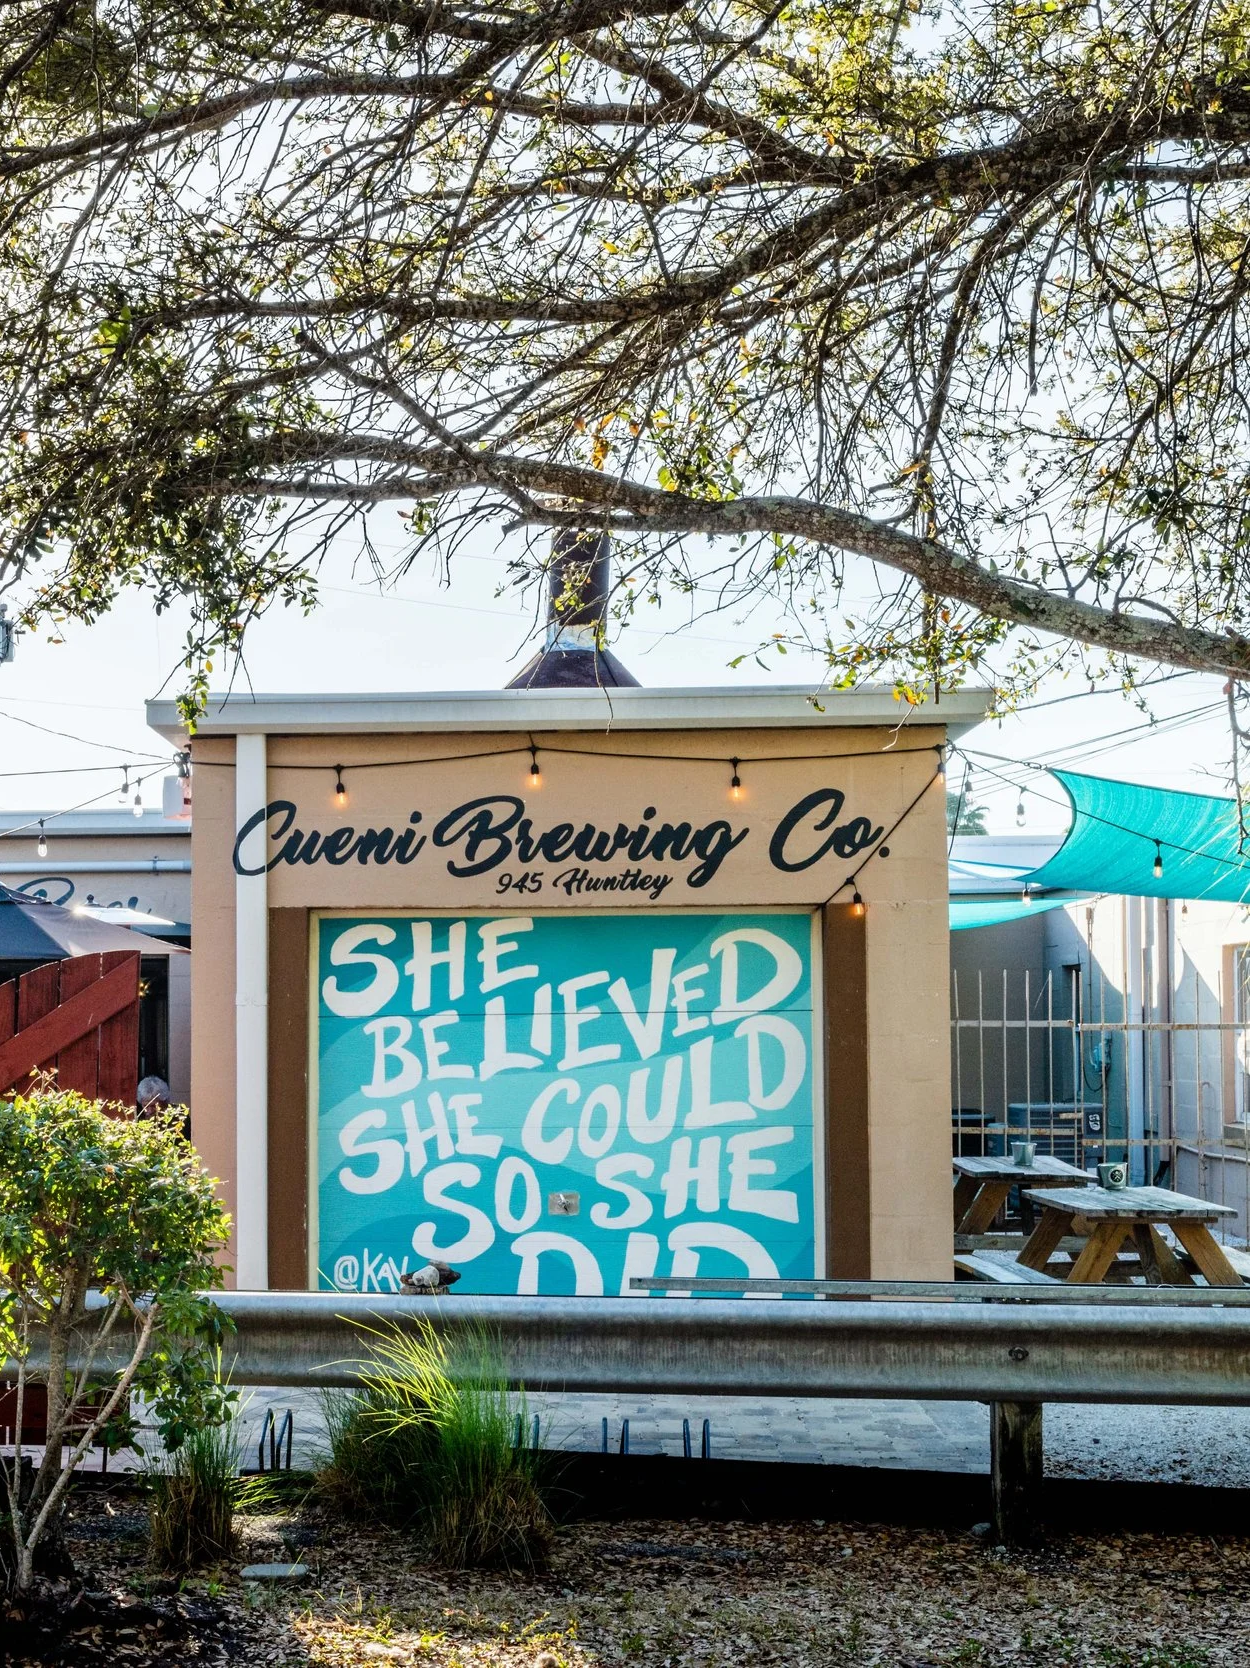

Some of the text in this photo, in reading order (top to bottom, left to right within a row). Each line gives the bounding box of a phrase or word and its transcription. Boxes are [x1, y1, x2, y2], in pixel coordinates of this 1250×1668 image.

[233, 787, 890, 889] Cueni Brewing Co.
[495, 867, 674, 900] 945 Huntley
[322, 917, 539, 1017] SHE
[361, 929, 802, 1098] BELIEVED
[338, 1015, 806, 1195] SHE COULD
[412, 1126, 800, 1264] SO SHE
